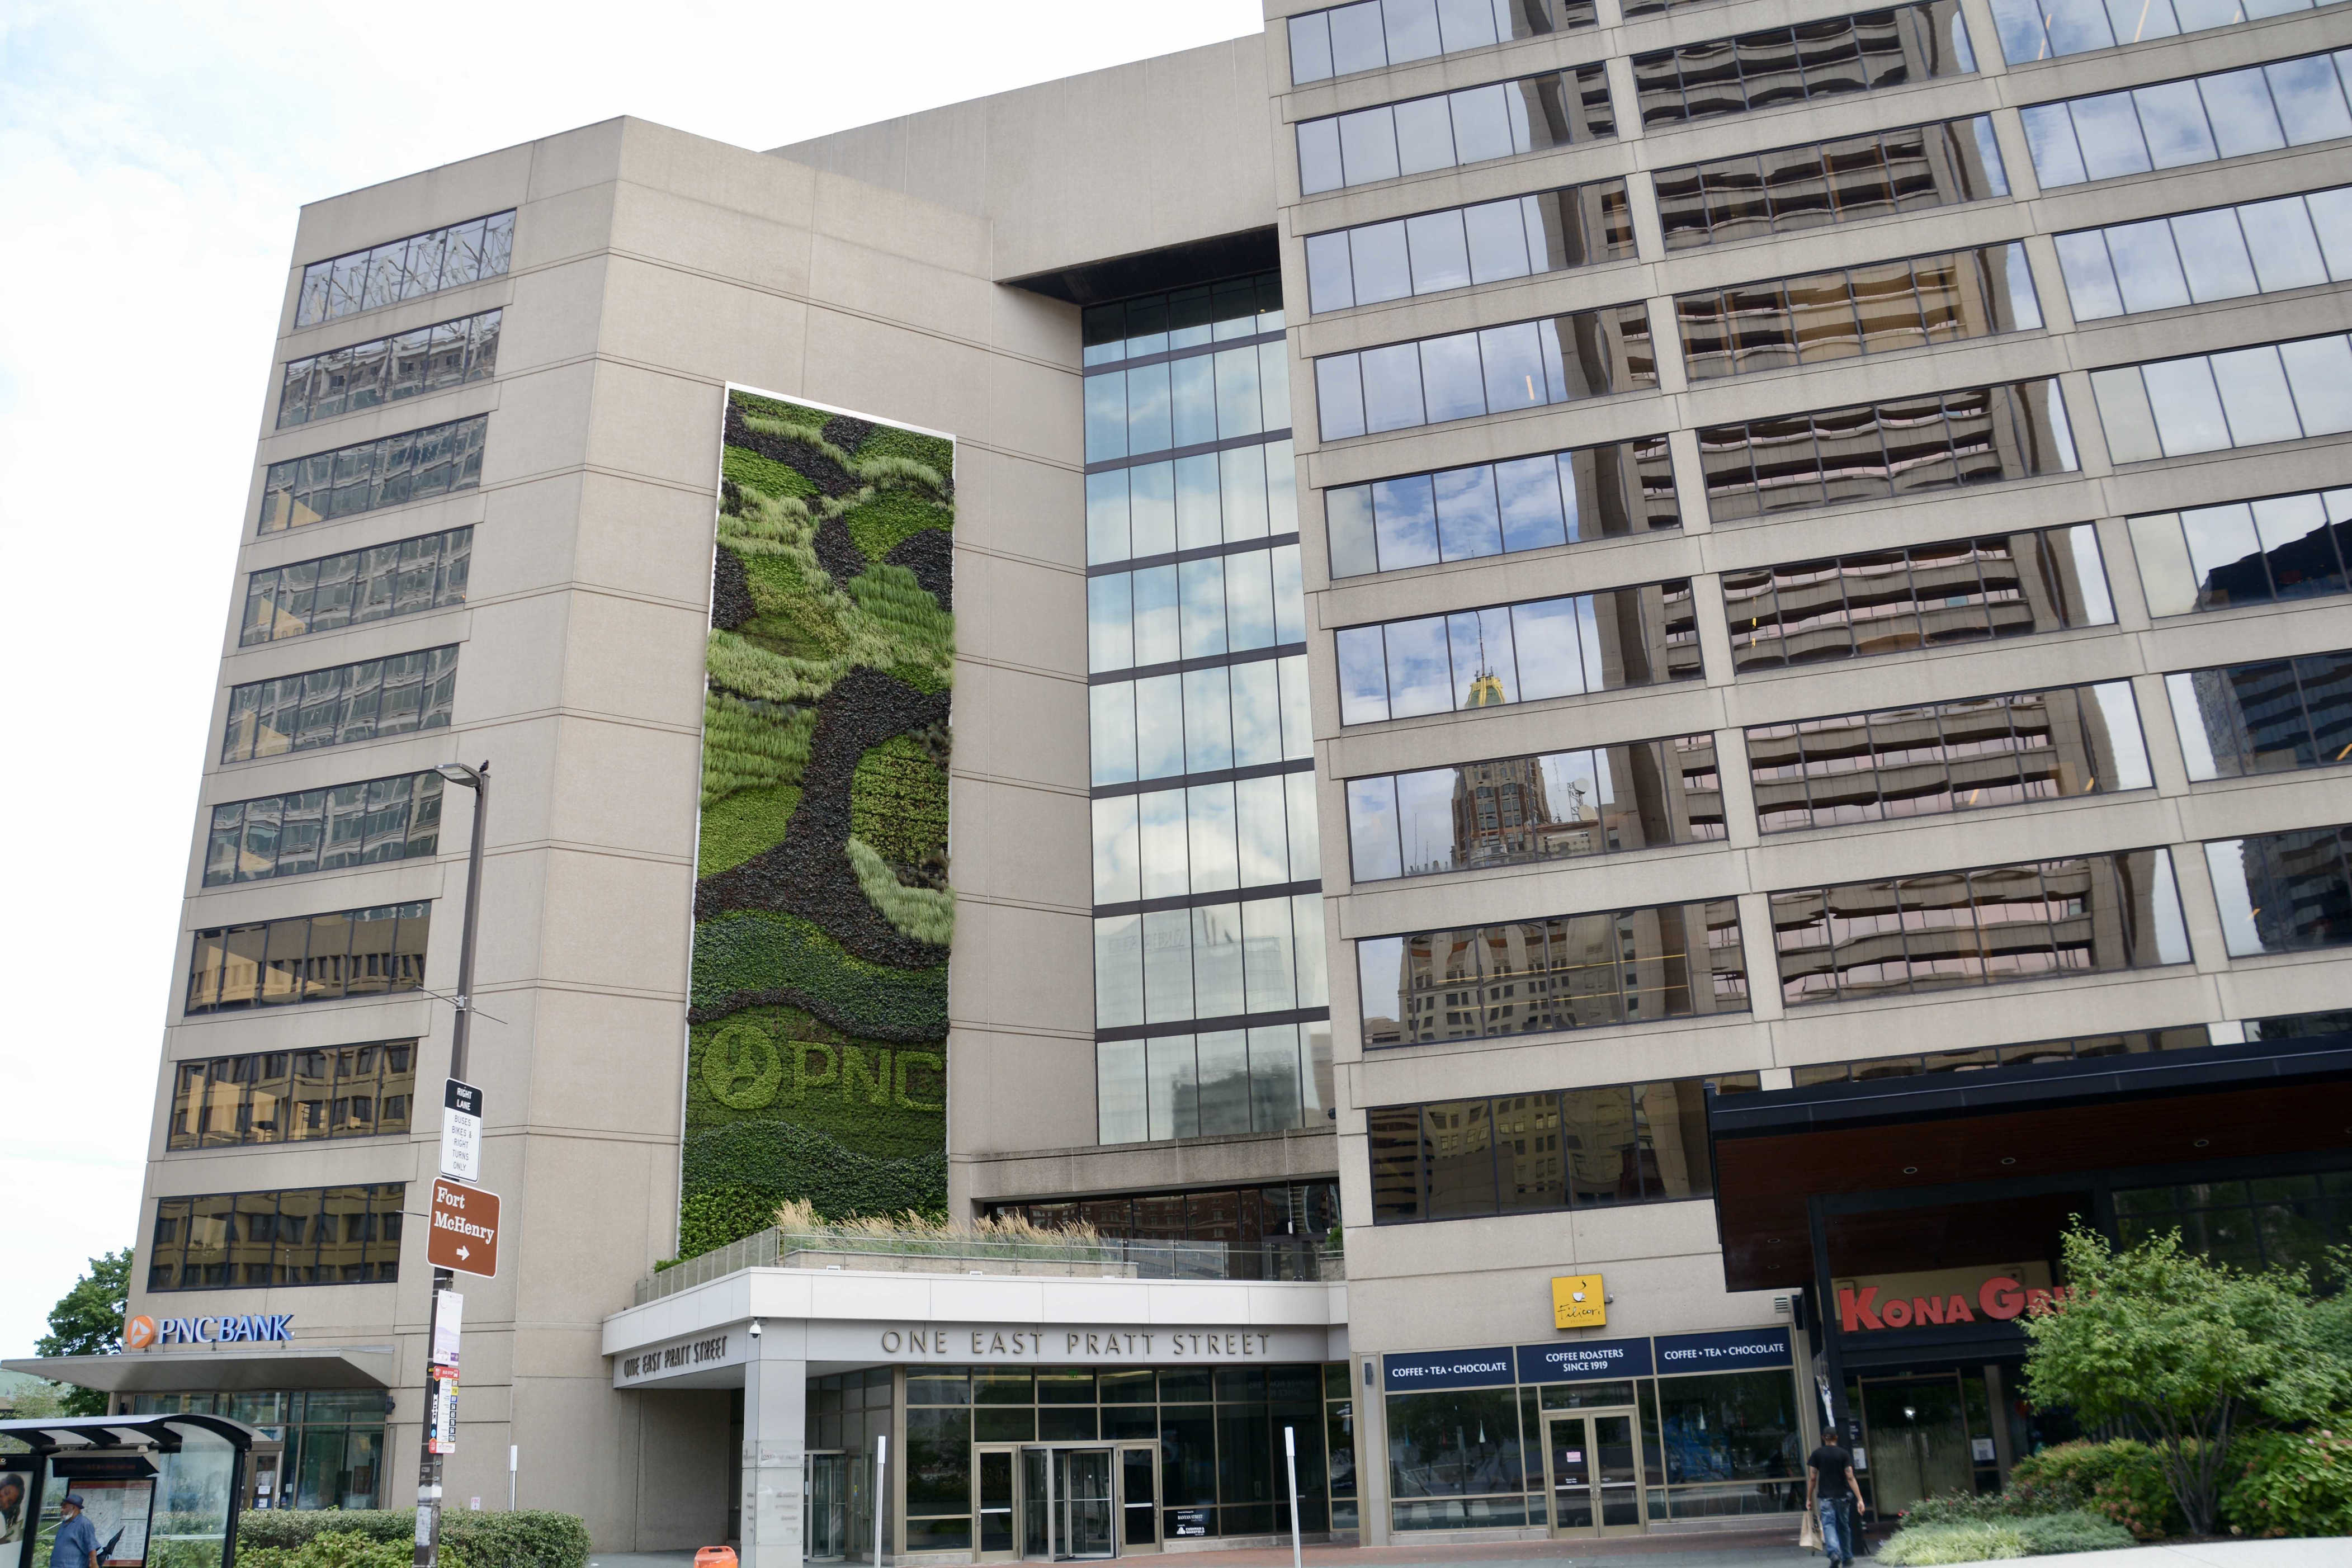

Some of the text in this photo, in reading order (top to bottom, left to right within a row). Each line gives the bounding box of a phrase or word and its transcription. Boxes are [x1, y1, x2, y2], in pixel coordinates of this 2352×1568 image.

[788, 1040, 943, 1112] PNC
[456, 1087, 473, 1099] RIGHT
[456, 1098, 471, 1111] LANE
[454, 1114, 471, 1127] BUSES
[452, 1126, 466, 1137] BIKES
[454, 1138, 469, 1148] RIGHT
[453, 1149, 469, 1161] TURNS
[453, 1161, 466, 1172] ONLY
[436, 1186, 465, 1209] Fort
[434, 1211, 494, 1244] McHenry
[1557, 1303, 1602, 1320] Filicori
[1839, 1286, 1975, 1332] KONA
[158, 1314, 294, 1344] PNC BANK
[882, 1329, 1270, 1355] ONE EAST PRATT STREET
[624, 1335, 727, 1377] ONE EAST PRATT STREET
[1546, 1349, 1624, 1362] COFFEE ROASTERS
[1664, 1343, 1784, 1360] COFFEE TEA CHOCOLATE
[1392, 1362, 1507, 1377] COFFEE TEA CHOCOLATE
[1563, 1361, 1608, 1372] SINCE 1919
